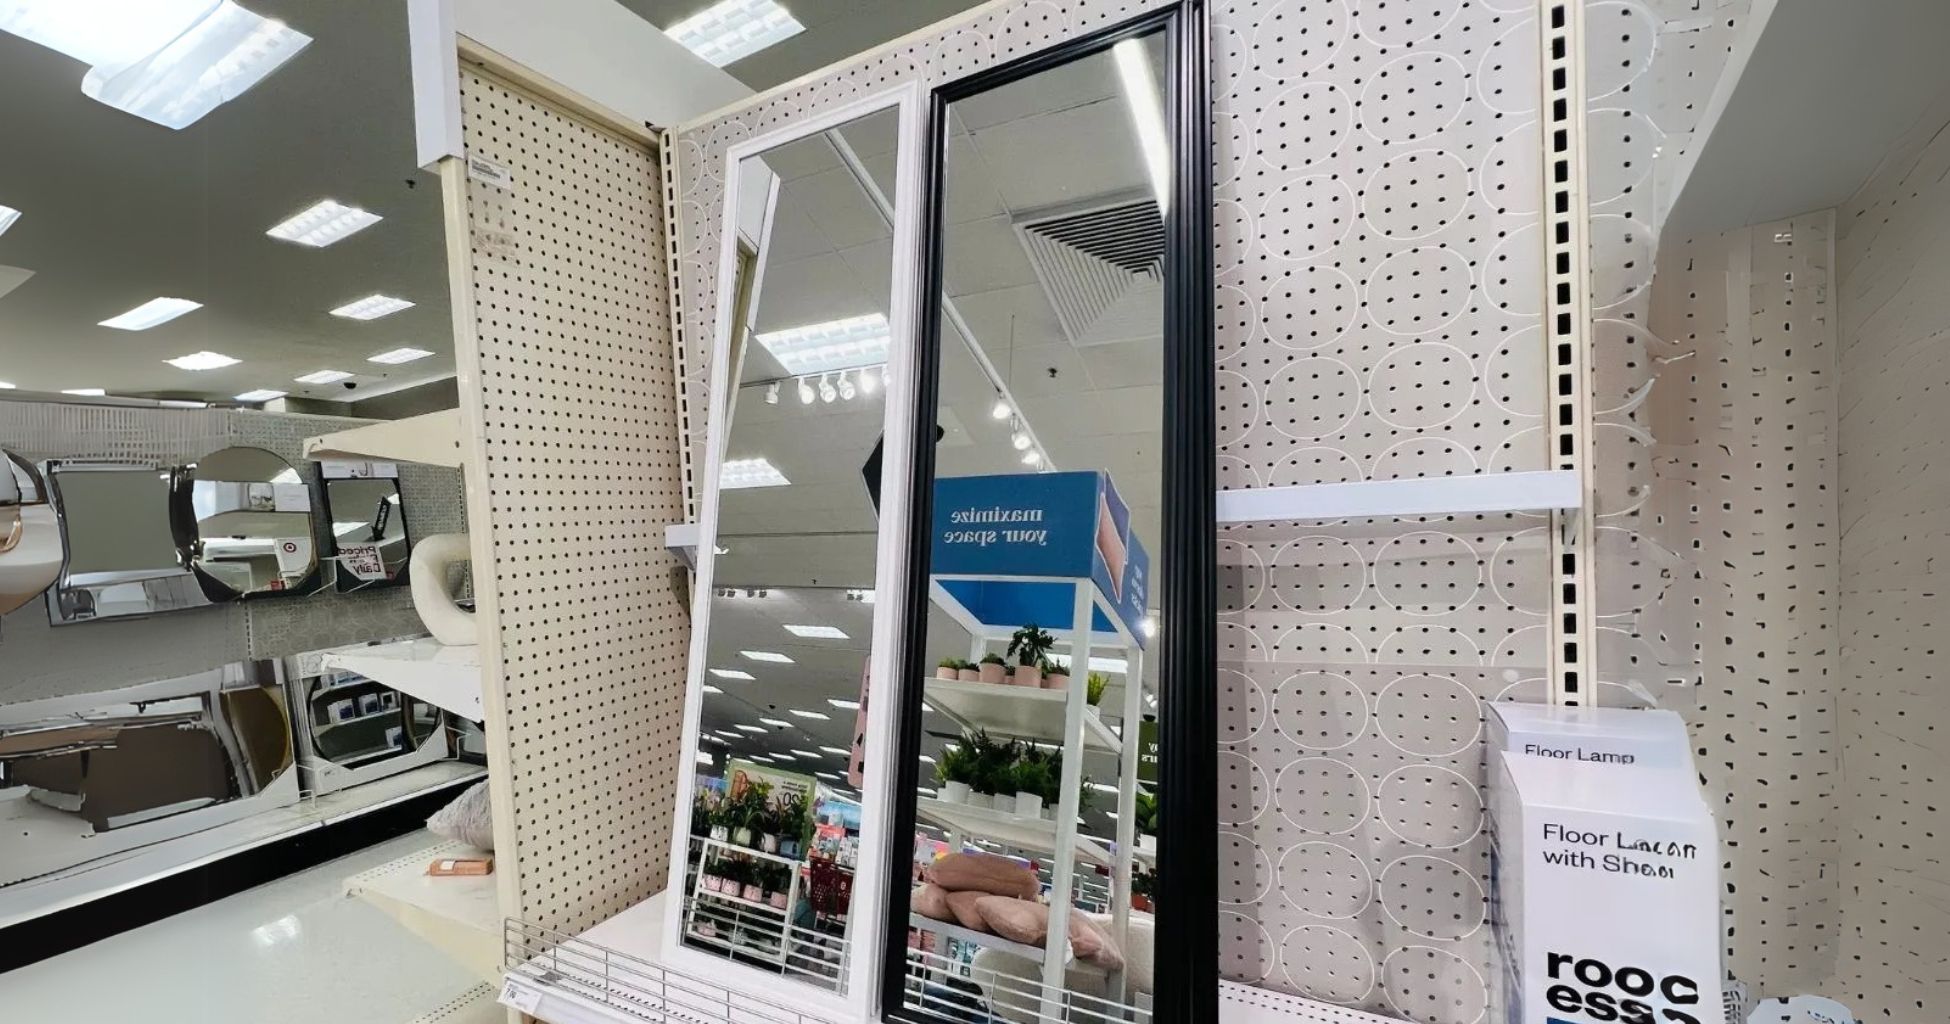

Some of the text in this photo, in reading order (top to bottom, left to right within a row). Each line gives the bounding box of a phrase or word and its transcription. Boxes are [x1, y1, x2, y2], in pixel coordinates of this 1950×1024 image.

[1525, 743, 1635, 765] Floor Lamp
[1543, 823, 1609, 846] Floor
[1543, 850, 1595, 869] with
